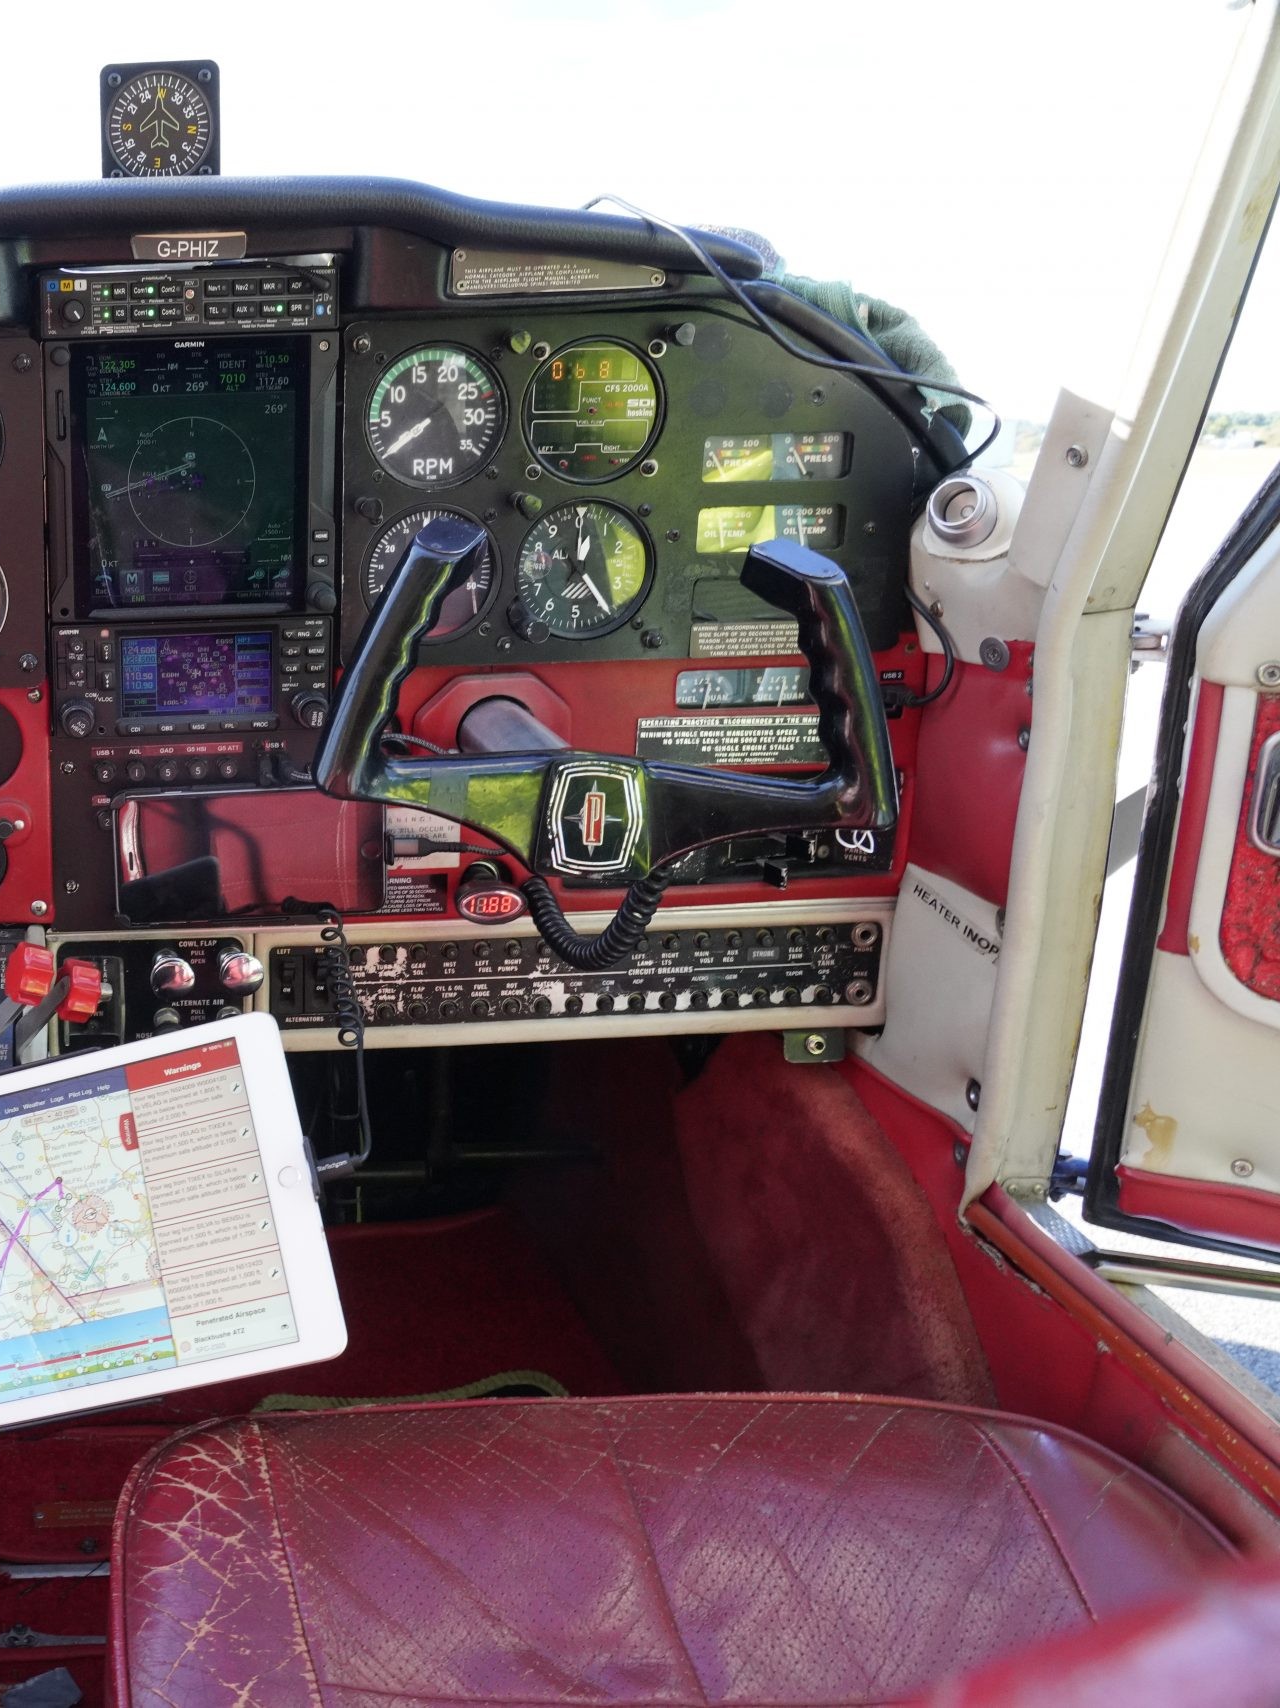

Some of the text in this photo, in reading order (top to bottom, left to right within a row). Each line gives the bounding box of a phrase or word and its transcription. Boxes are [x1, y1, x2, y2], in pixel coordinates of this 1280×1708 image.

[139, 90, 151, 104] 24
[171, 92, 183, 105] 30
[187, 126, 196, 134] N
[158, 240, 219, 258] G-PHIZ
[219, 360, 246, 369] IDENT
[220, 374, 245, 384] 7010
[412, 367, 427, 383] 15
[438, 365, 458, 382] 20
[100, 382, 136, 391] 124.600
[390, 386, 406, 403] 10
[458, 383, 478, 400] 25
[381, 411, 391, 427] 5
[463, 408, 484, 425] 30
[460, 440, 472, 450] 35
[413, 458, 453, 475] RPM
[914, 884, 1000, 954] HEATER INOP
[658, 966, 694, 975] BREAKERS
[164, 1061, 201, 1077] Warnings
[23, 1100, 45, 1110] Weather
[196, 1307, 266, 1326] Penetrated Airspace
